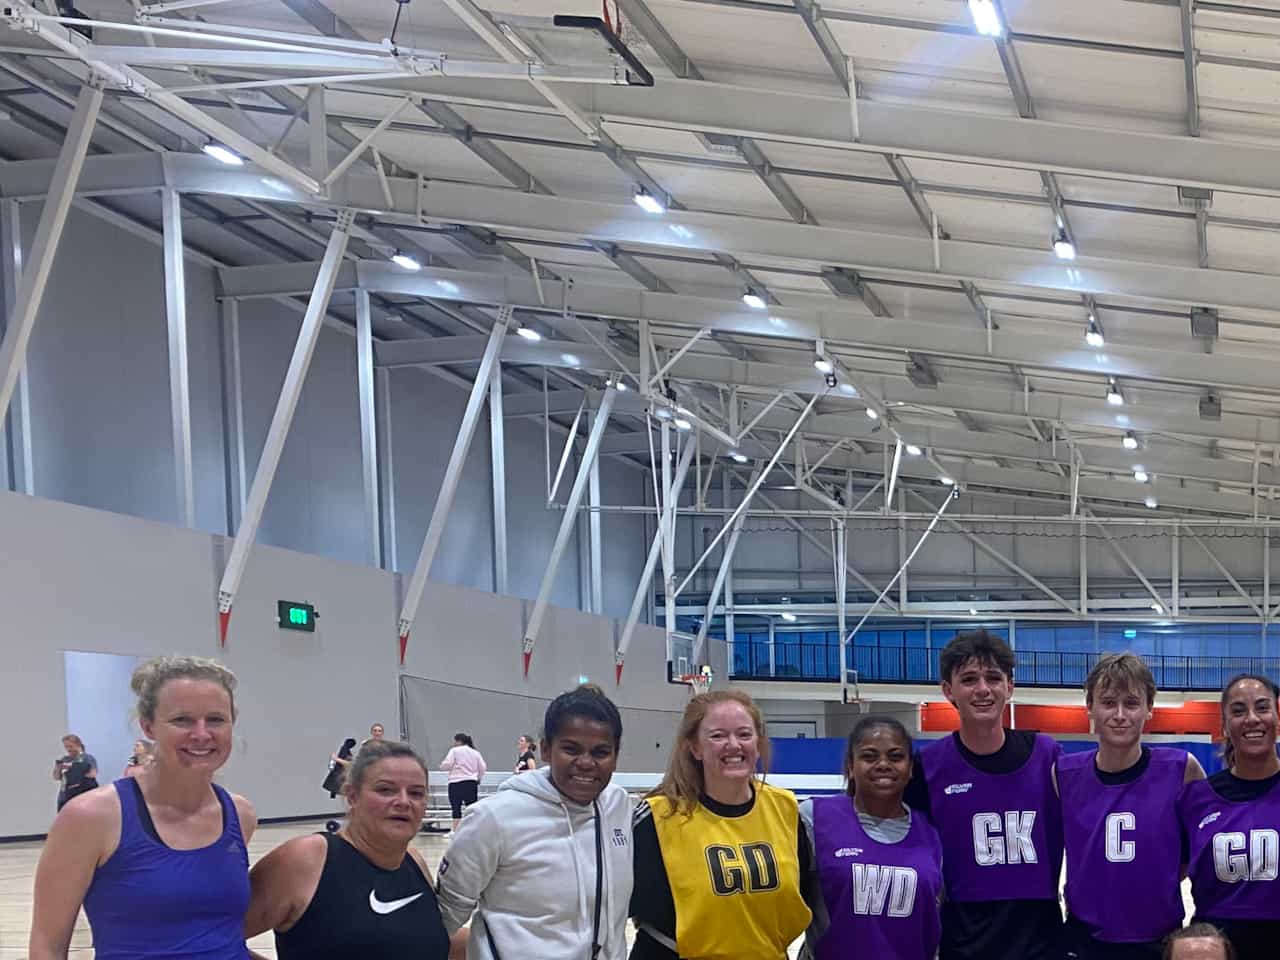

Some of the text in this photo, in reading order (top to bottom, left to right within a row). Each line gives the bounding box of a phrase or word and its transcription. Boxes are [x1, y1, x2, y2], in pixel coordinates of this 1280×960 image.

[971, 810, 1039, 866] GK
[1104, 811, 1137, 864] C
[1212, 828, 1280, 884] GD
[705, 841, 781, 896] GD
[851, 862, 919, 918] WD
